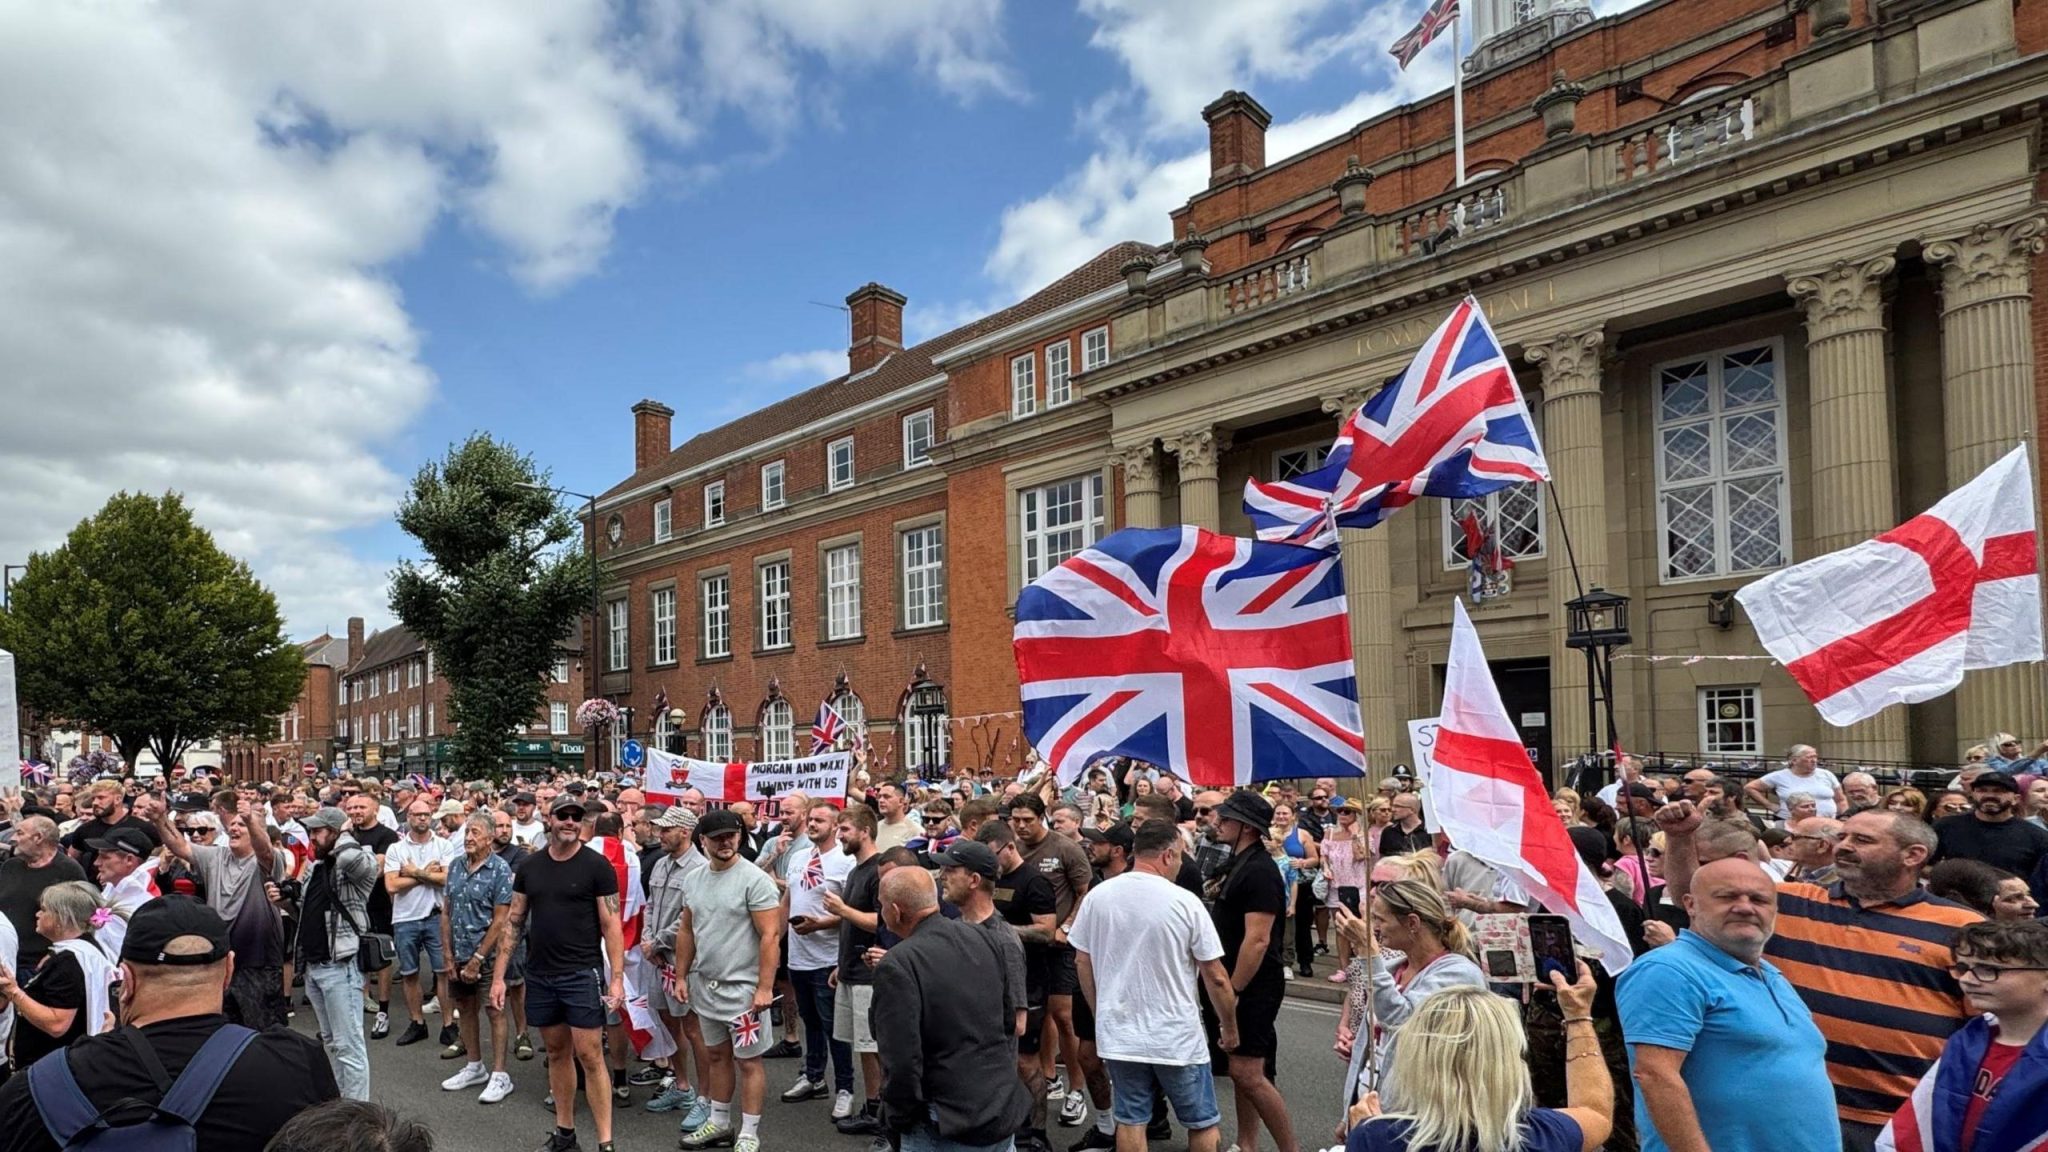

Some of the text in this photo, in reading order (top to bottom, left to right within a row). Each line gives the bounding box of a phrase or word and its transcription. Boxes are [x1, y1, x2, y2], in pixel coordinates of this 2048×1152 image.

[752, 763, 793, 774] MORGAN
[796, 762, 817, 774] AND
[797, 778, 821, 790] WITH
[824, 777, 837, 789] US
